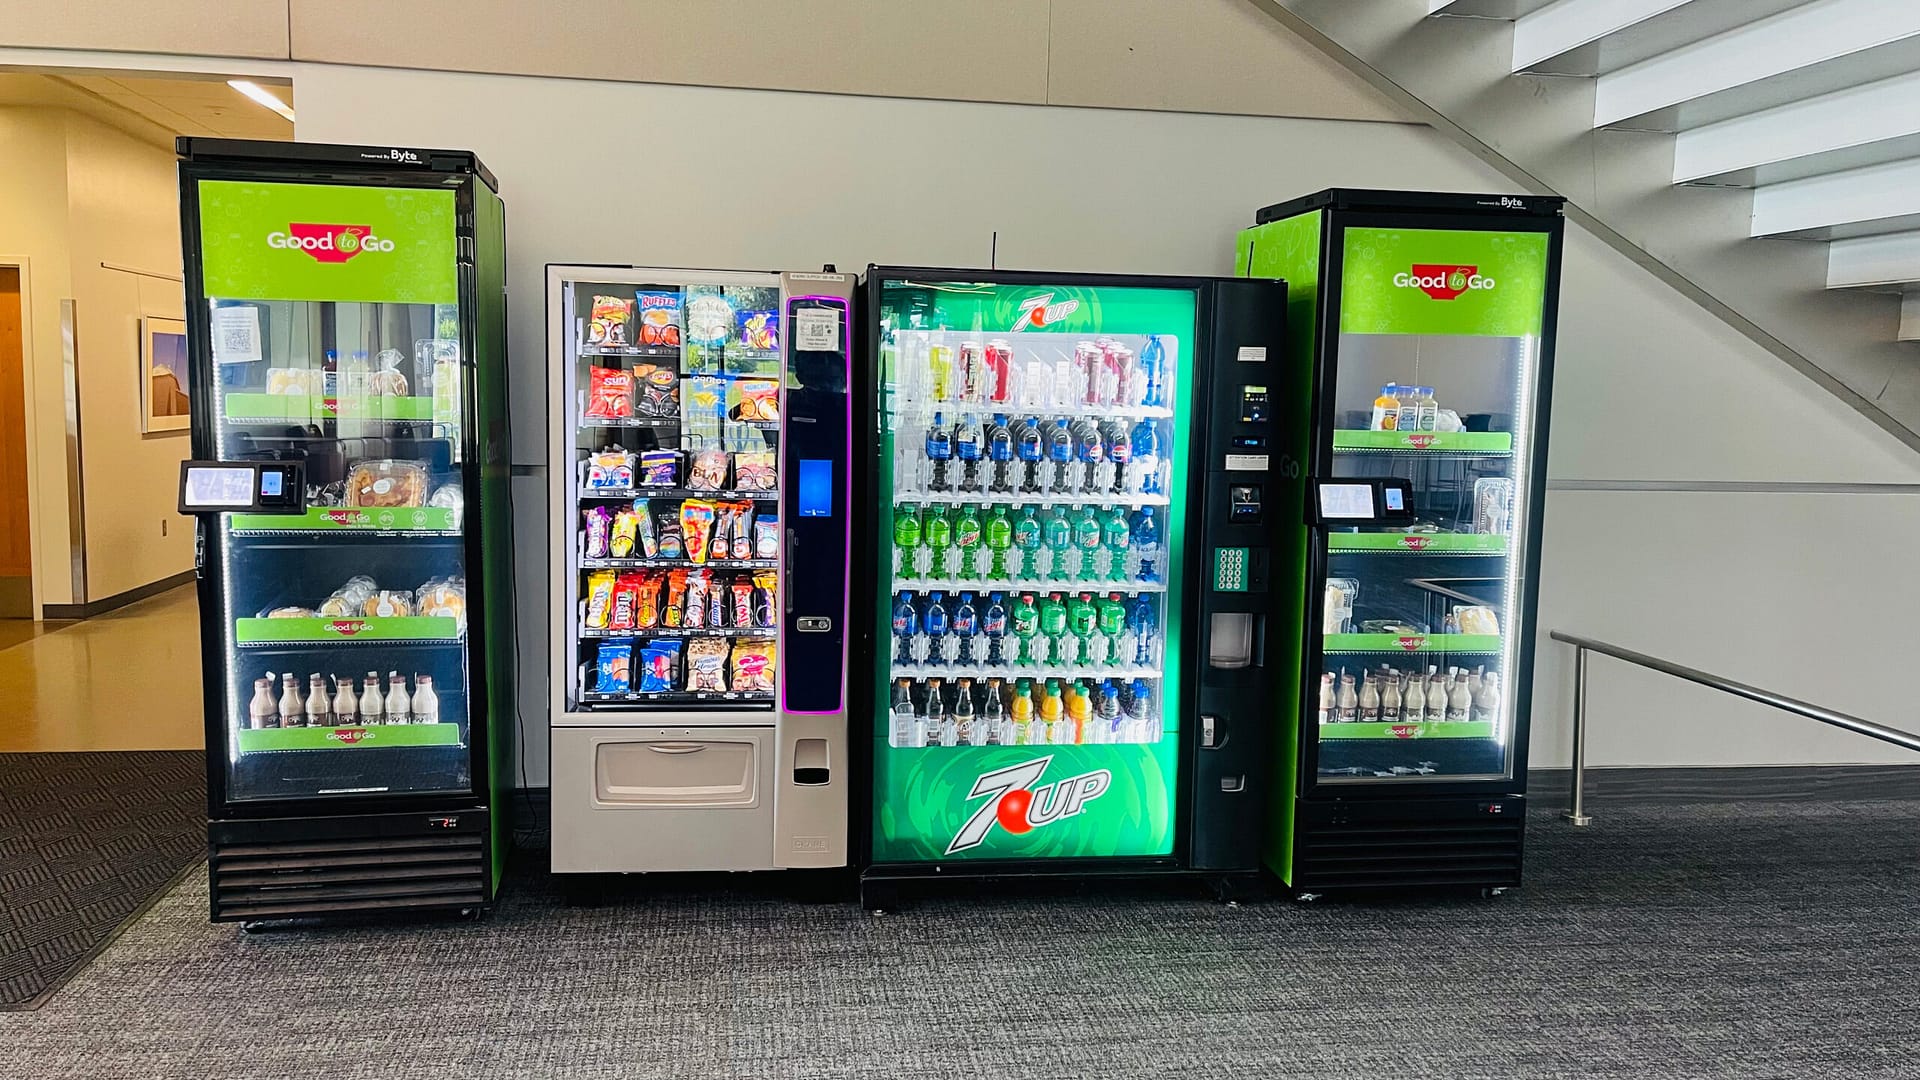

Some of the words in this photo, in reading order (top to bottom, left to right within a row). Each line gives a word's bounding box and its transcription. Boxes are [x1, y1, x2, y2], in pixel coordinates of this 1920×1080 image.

[391, 149, 417, 162] Byte
[1501, 196, 1523, 208] Byte
[267, 232, 334, 250] Good
[341, 234, 357, 249] to
[361, 235, 395, 252] Go
[1393, 272, 1446, 289] Good
[1451, 273, 1465, 287] to
[1468, 274, 1496, 289] Go
[1010, 293, 1080, 334] 7UP
[1402, 437, 1423, 445] Good
[320, 513, 346, 521] Good
[356, 513, 371, 521] Go
[323, 623, 350, 631] Good
[326, 732, 352, 740] Good
[1384, 727, 1406, 735] Good
[944, 754, 1112, 856] 7UP
